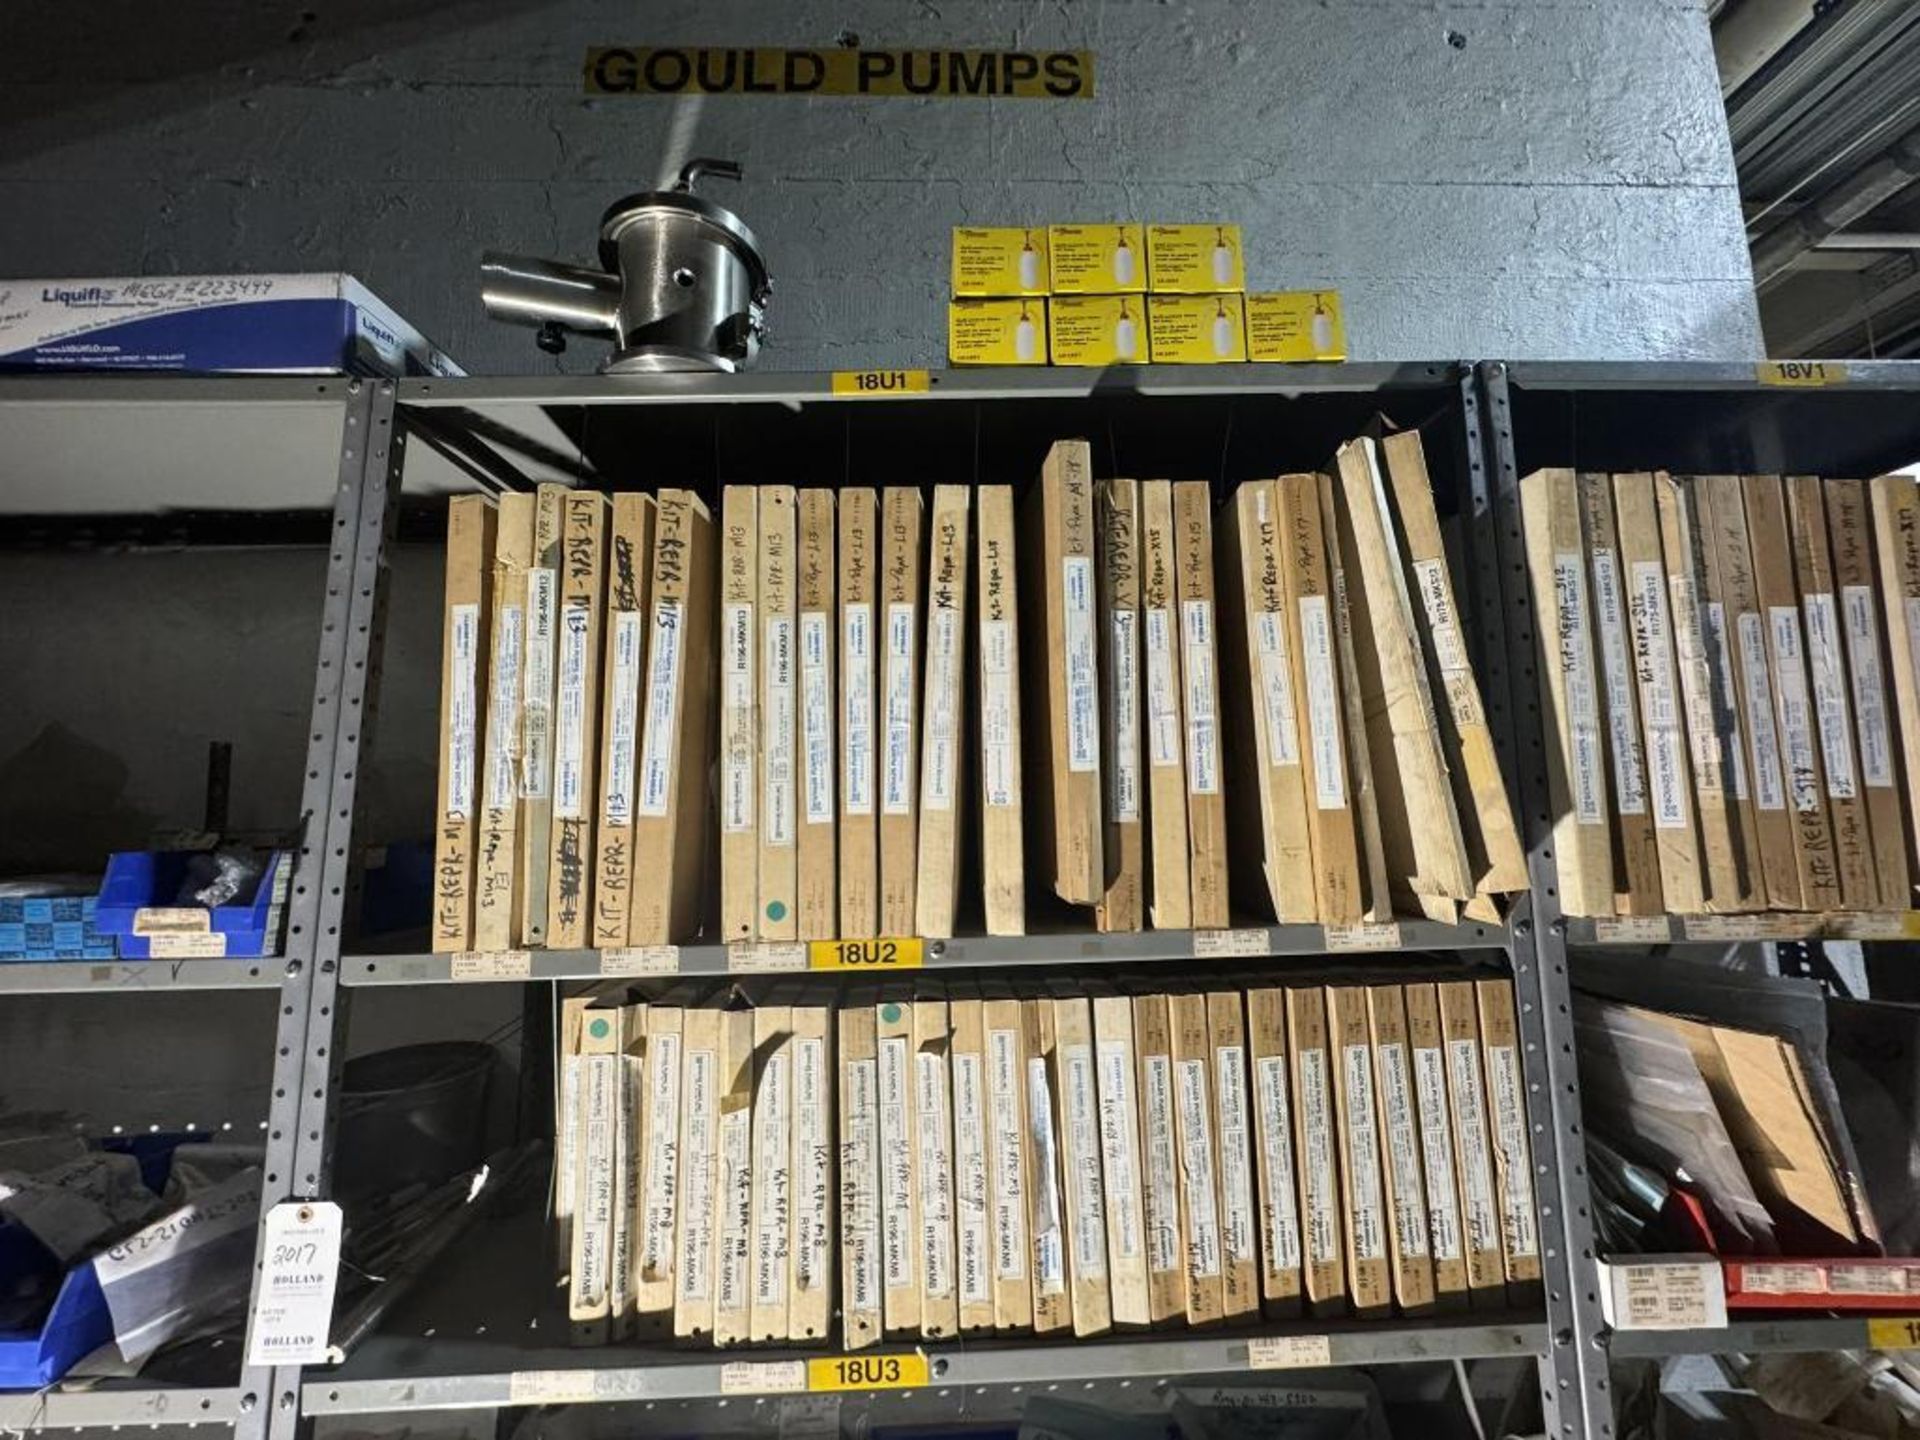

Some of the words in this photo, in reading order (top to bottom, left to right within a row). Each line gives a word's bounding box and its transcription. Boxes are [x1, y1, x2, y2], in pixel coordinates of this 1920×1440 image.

[593, 48, 825, 95] GOULD
[860, 50, 1081, 97] PUMPS
[855, 373, 906, 391] 18U1
[1776, 362, 1826, 381] 18V1
[837, 943, 897, 965] 18U2
[272, 1242, 317, 1266] 2017
[837, 1359, 901, 1384] 18U3
